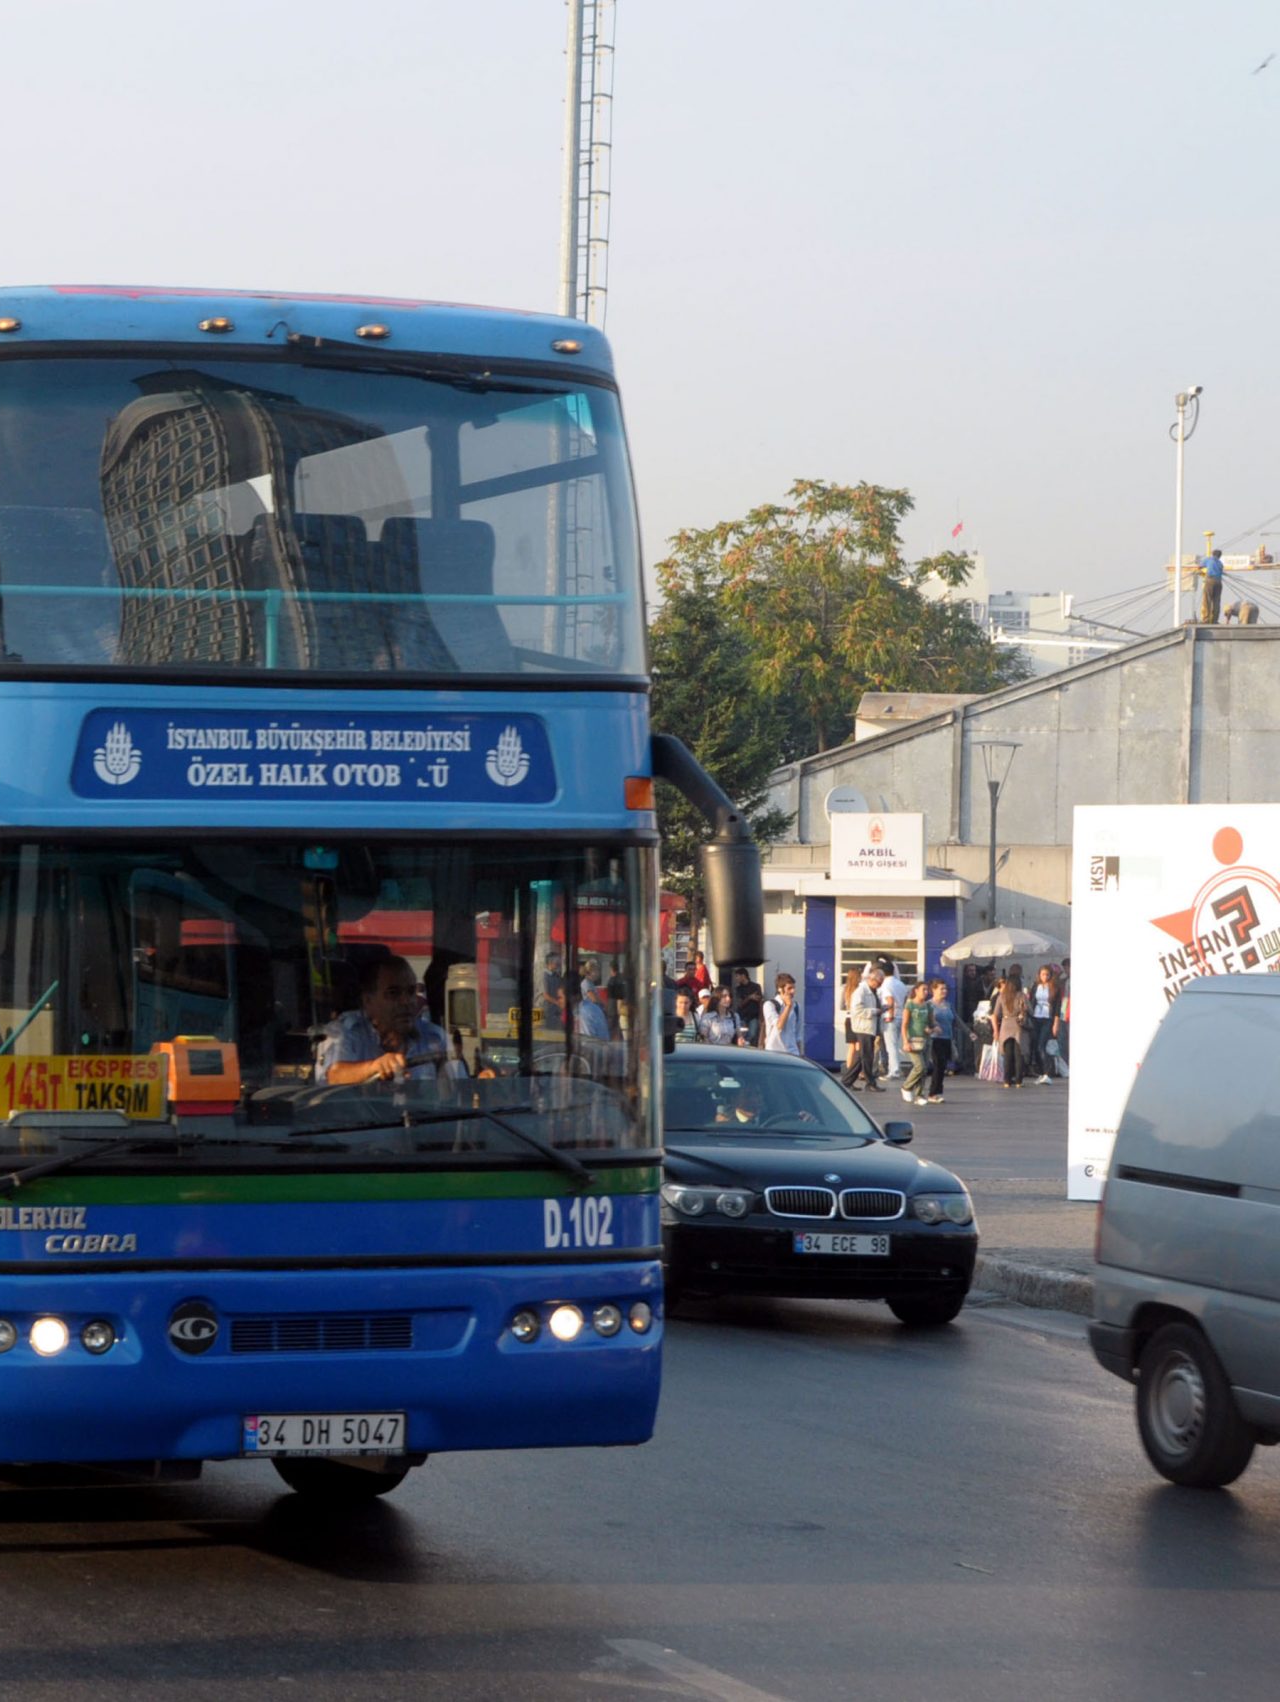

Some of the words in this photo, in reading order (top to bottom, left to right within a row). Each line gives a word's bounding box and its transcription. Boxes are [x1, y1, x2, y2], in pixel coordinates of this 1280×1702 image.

[167, 722, 252, 750] İSTANBUL
[256, 722, 367, 756] BÜYÜKŞEHİR
[370, 725, 470, 751] BELEDİYESİ
[187, 757, 253, 786] ÖZEL
[260, 763, 327, 786] HALK
[332, 757, 449, 787] OTOBÜ
[67, 1058, 158, 1081] EKSPRES
[543, 1195, 614, 1248] D.102
[45, 1233, 137, 1253] COBRA
[804, 1235, 821, 1251] 34
[832, 1236, 857, 1252] ECE
[870, 1238, 888, 1253] 98
[258, 1419, 287, 1446] 34
[302, 1418, 331, 1446] DH
[342, 1418, 400, 1445] 5047
